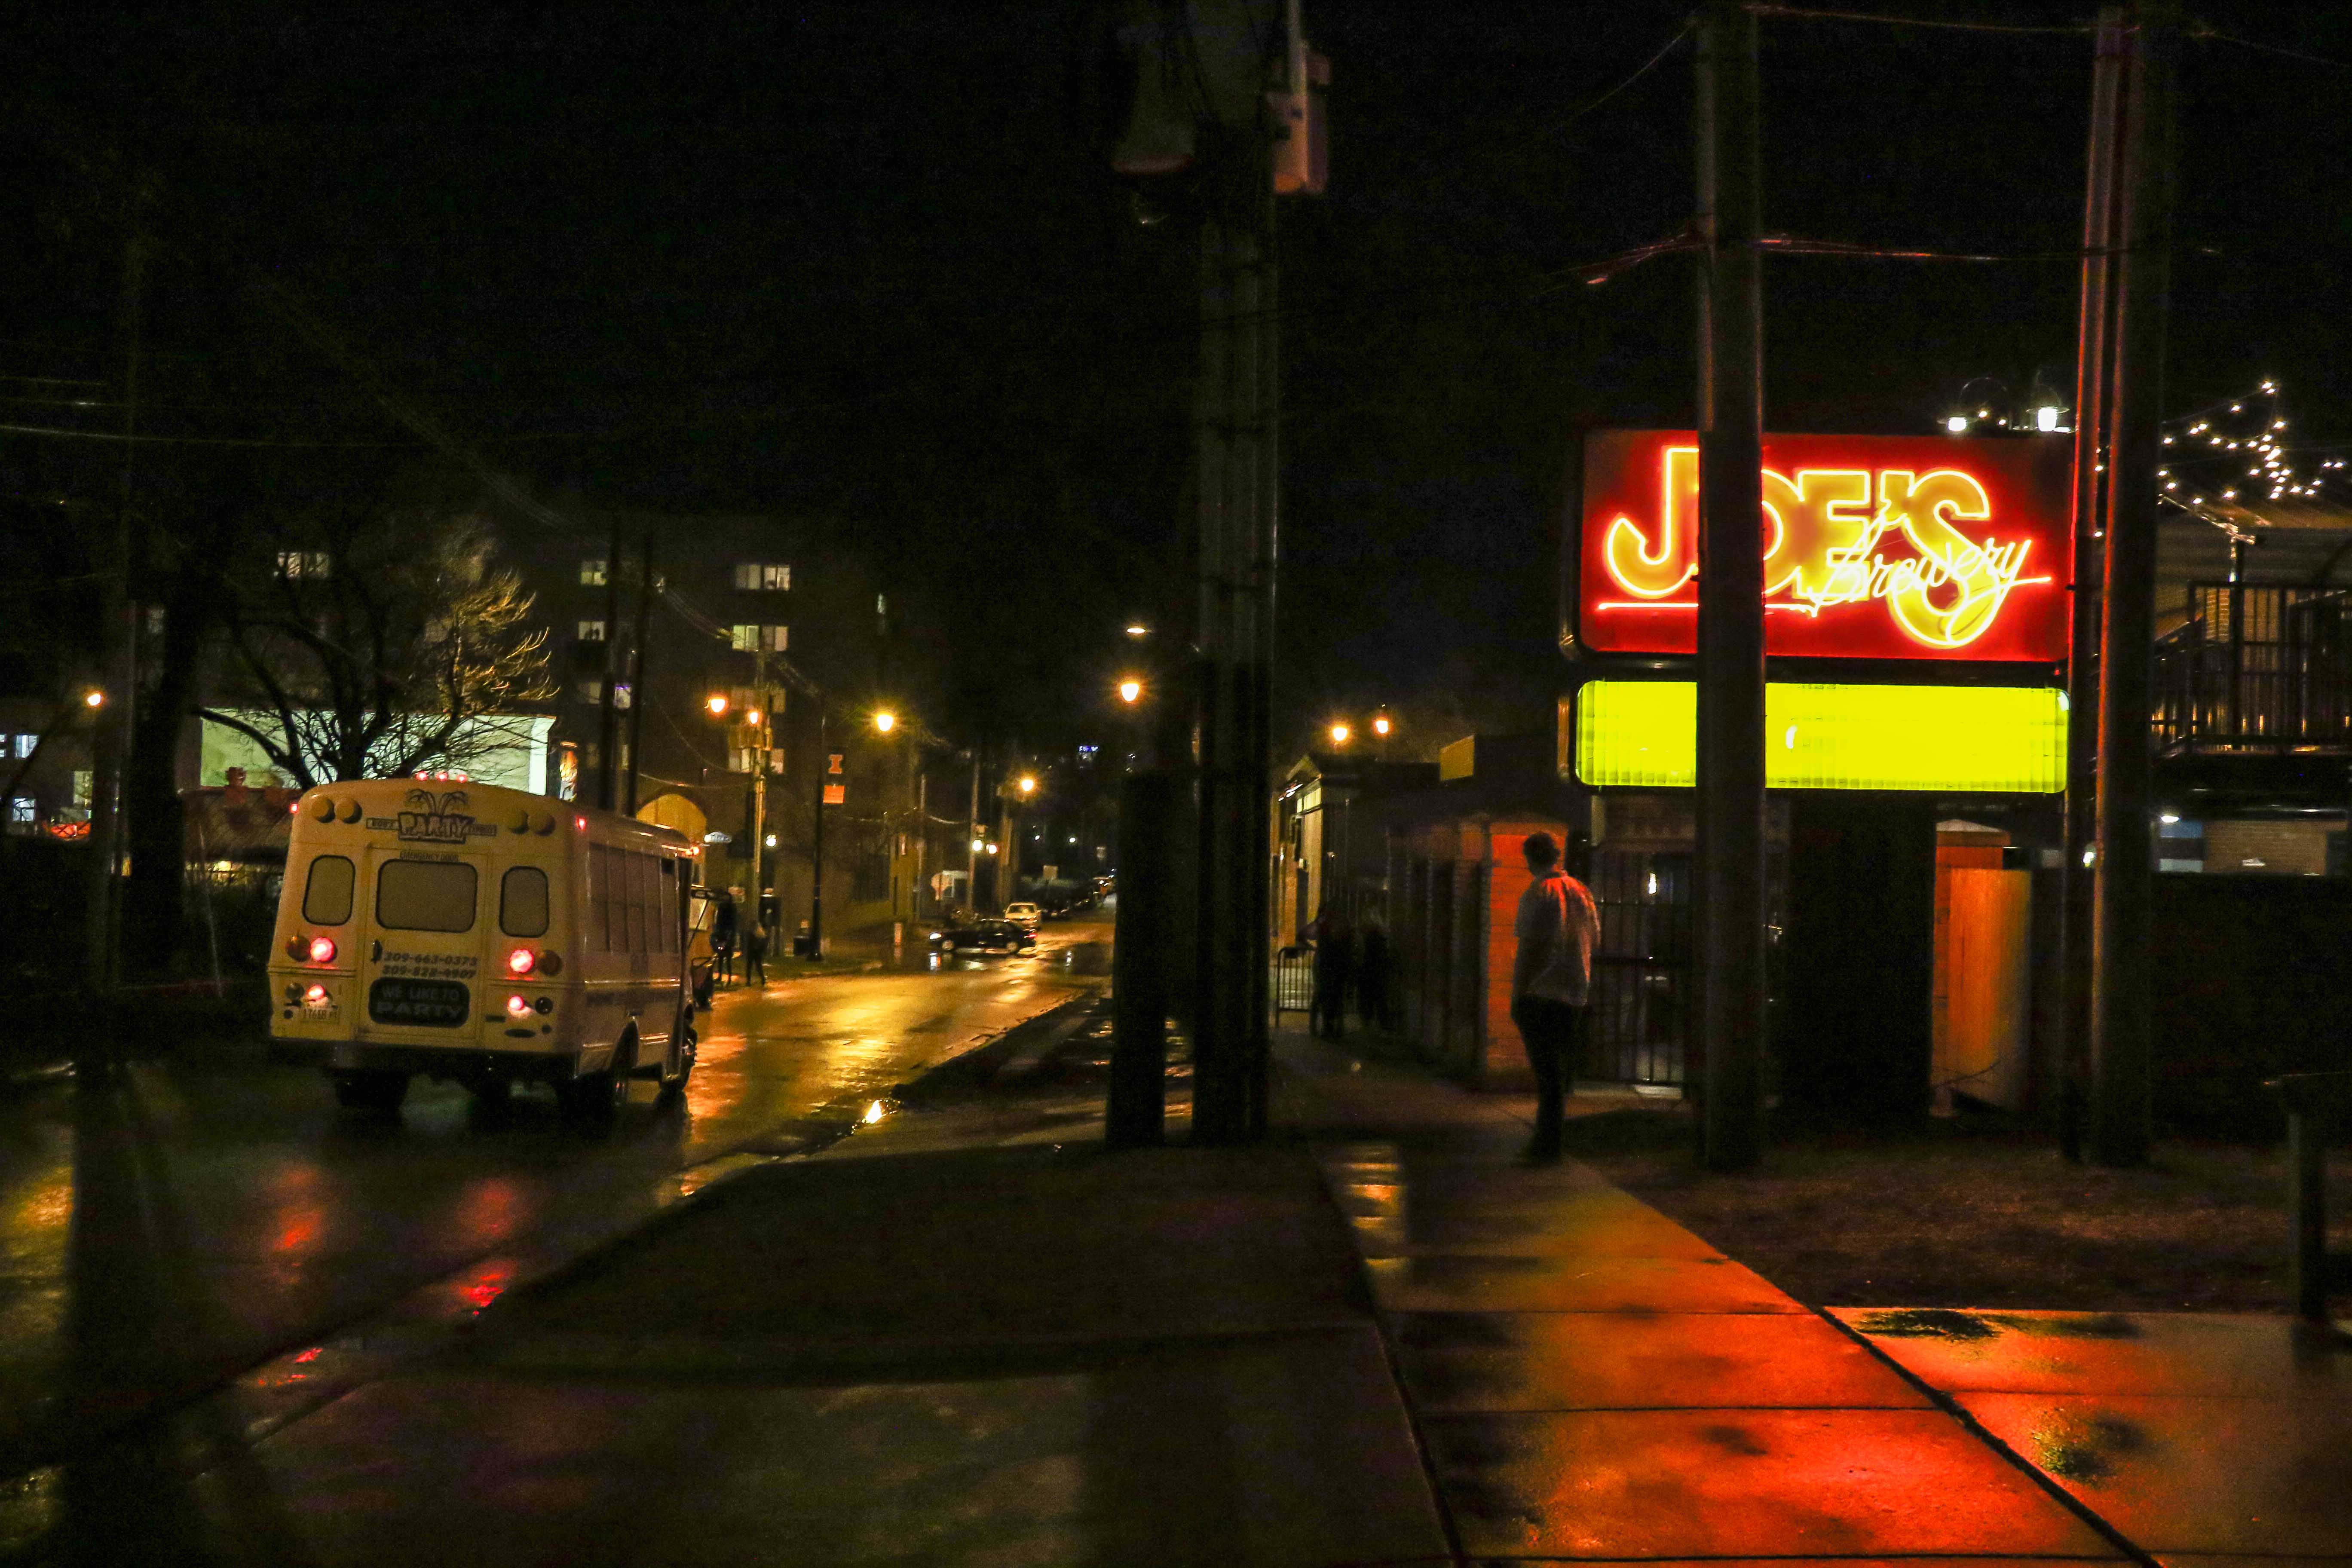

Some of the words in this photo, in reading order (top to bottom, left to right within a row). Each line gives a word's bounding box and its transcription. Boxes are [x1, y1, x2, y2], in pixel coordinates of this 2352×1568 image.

[400, 813, 468, 837] PARTY
[382, 984, 403, 998] WE
[409, 986, 438, 1000] LIKE
[376, 1001, 462, 1020] PARTY
